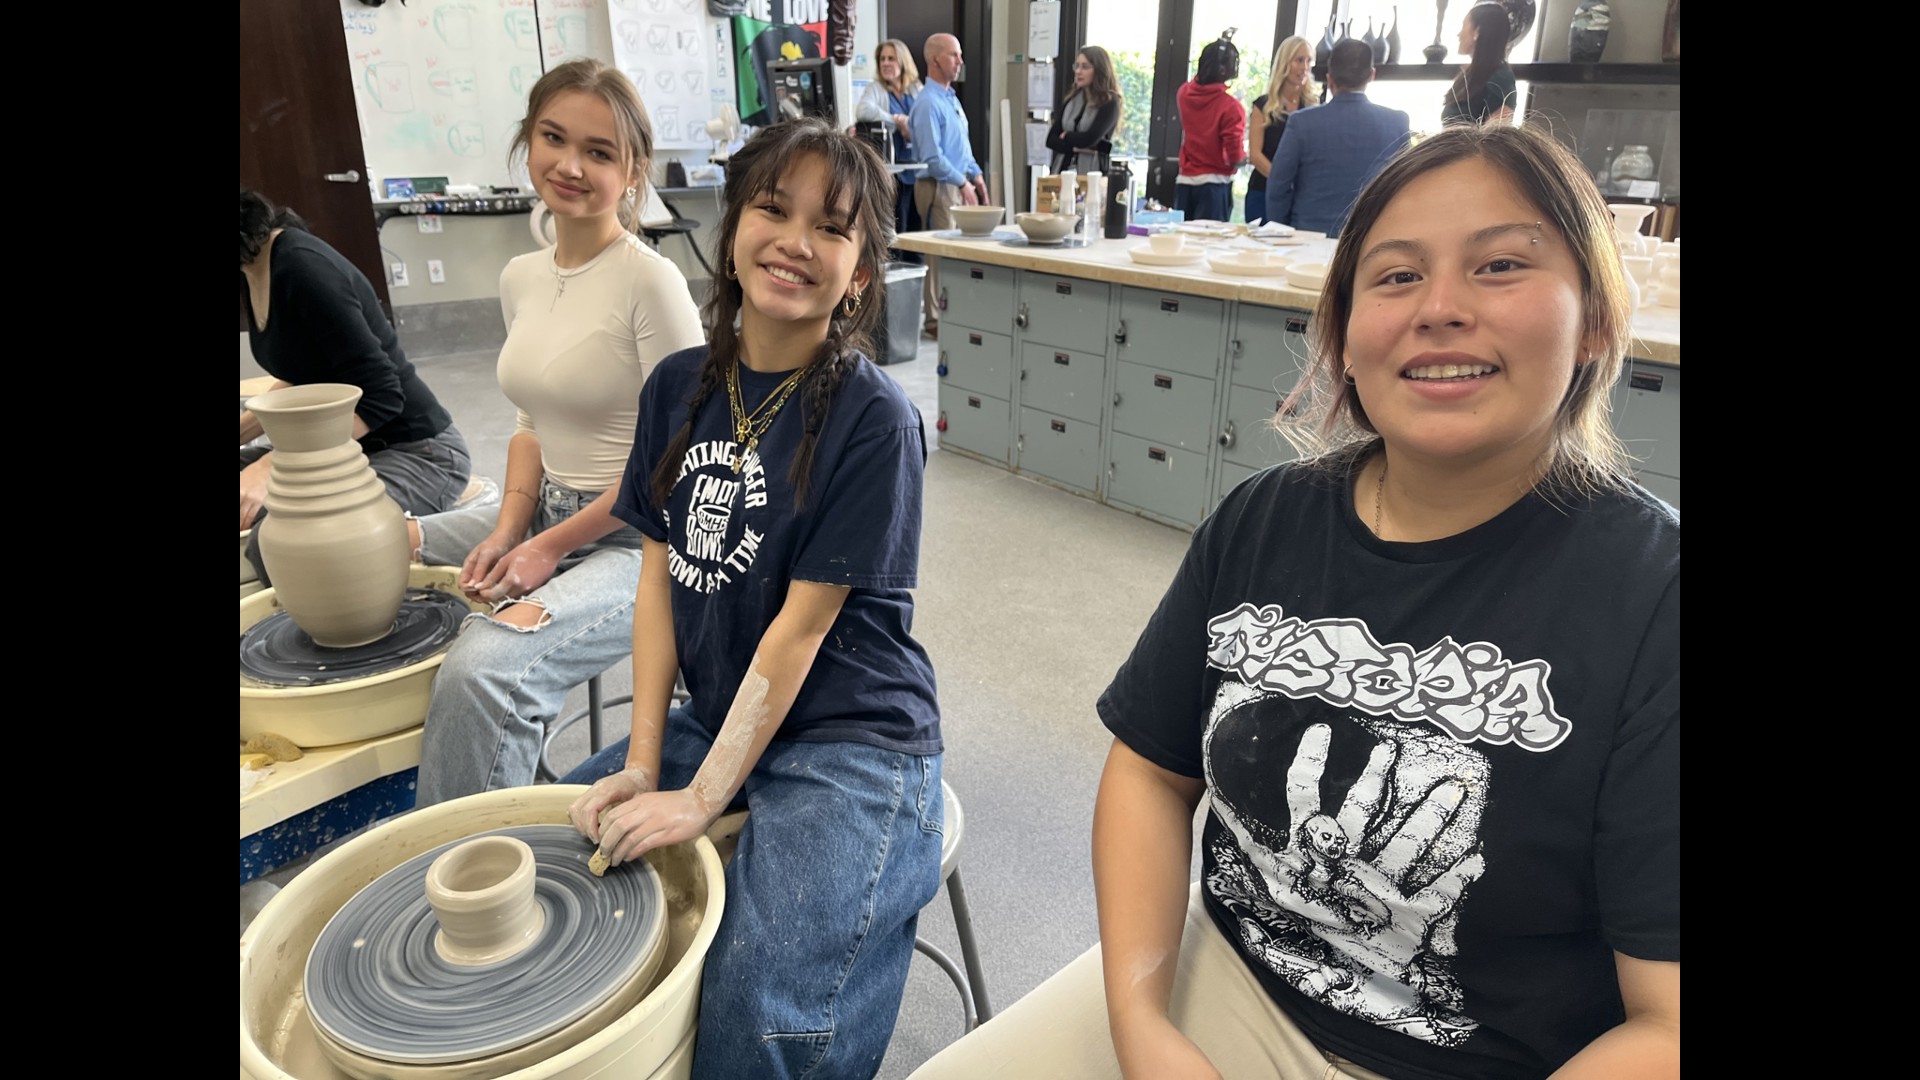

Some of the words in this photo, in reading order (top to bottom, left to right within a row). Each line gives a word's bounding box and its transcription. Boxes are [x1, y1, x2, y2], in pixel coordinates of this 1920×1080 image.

[744, 0, 771, 21] NE
[782, 0, 829, 25] LOVE
[671, 440, 738, 489] HTING
[688, 473, 741, 515] EMPT
